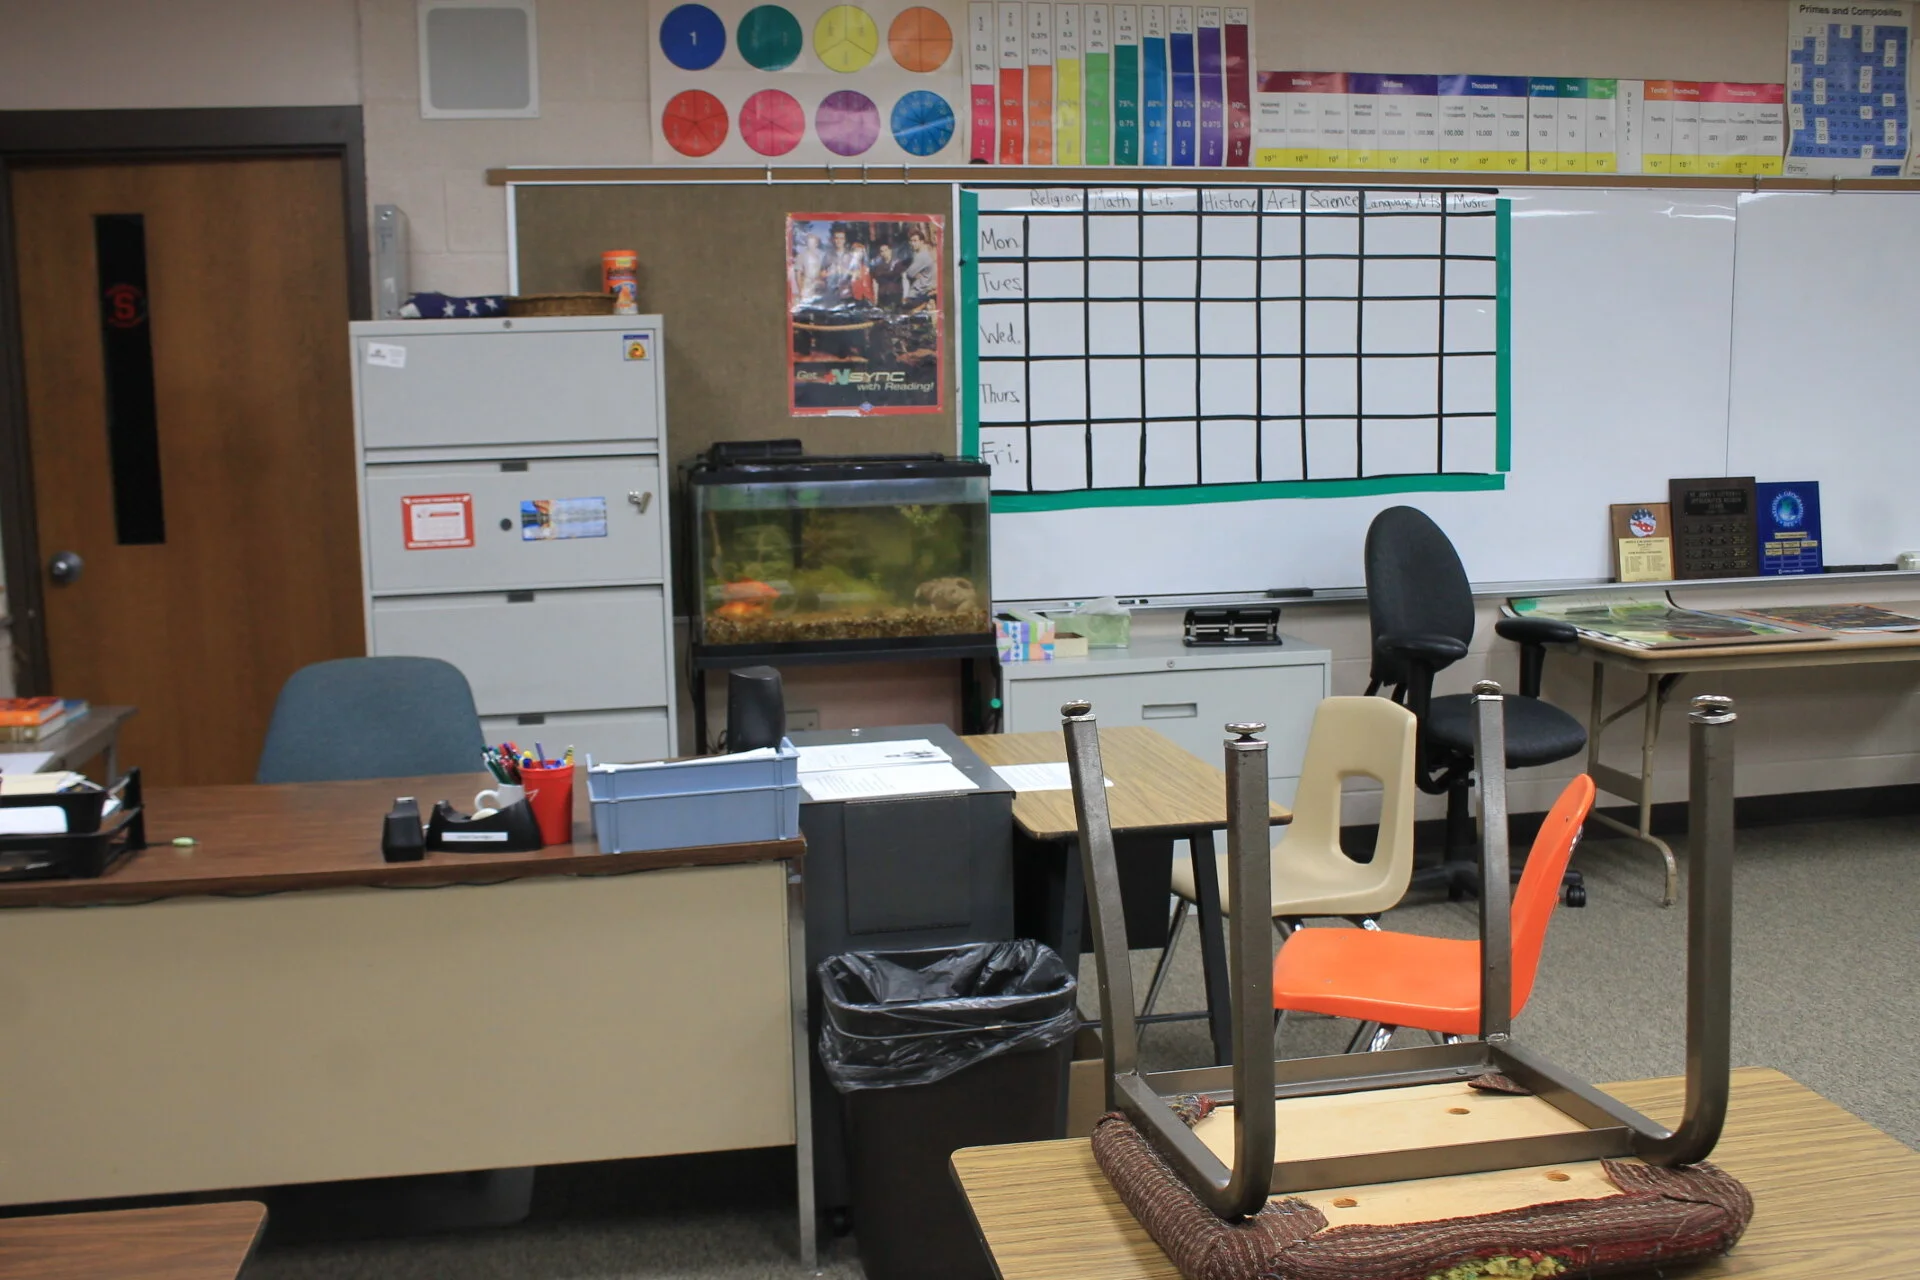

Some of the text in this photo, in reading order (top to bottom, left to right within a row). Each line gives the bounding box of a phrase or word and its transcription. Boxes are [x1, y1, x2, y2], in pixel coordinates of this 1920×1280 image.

[1799, 4, 1903, 18] Primes and Composites
[689, 31, 697, 46] 1
[1118, 120, 1135, 128] 0.75
[1030, 189, 1081, 208] Religion
[1093, 189, 1131, 210] Math
[1150, 193, 1174, 206] Lit.
[1203, 191, 1256, 211] History
[1266, 190, 1298, 210] Art
[1309, 191, 1360, 209] Science
[1365, 191, 1441, 211] Language Arts
[1453, 193, 1489, 211] Music
[114, 292, 135, 320] S
[980, 321, 1021, 345] Wed.
[796, 371, 818, 380] Get
[857, 381, 935, 392] with Reading!
[981, 441, 1019, 465] Fri.
